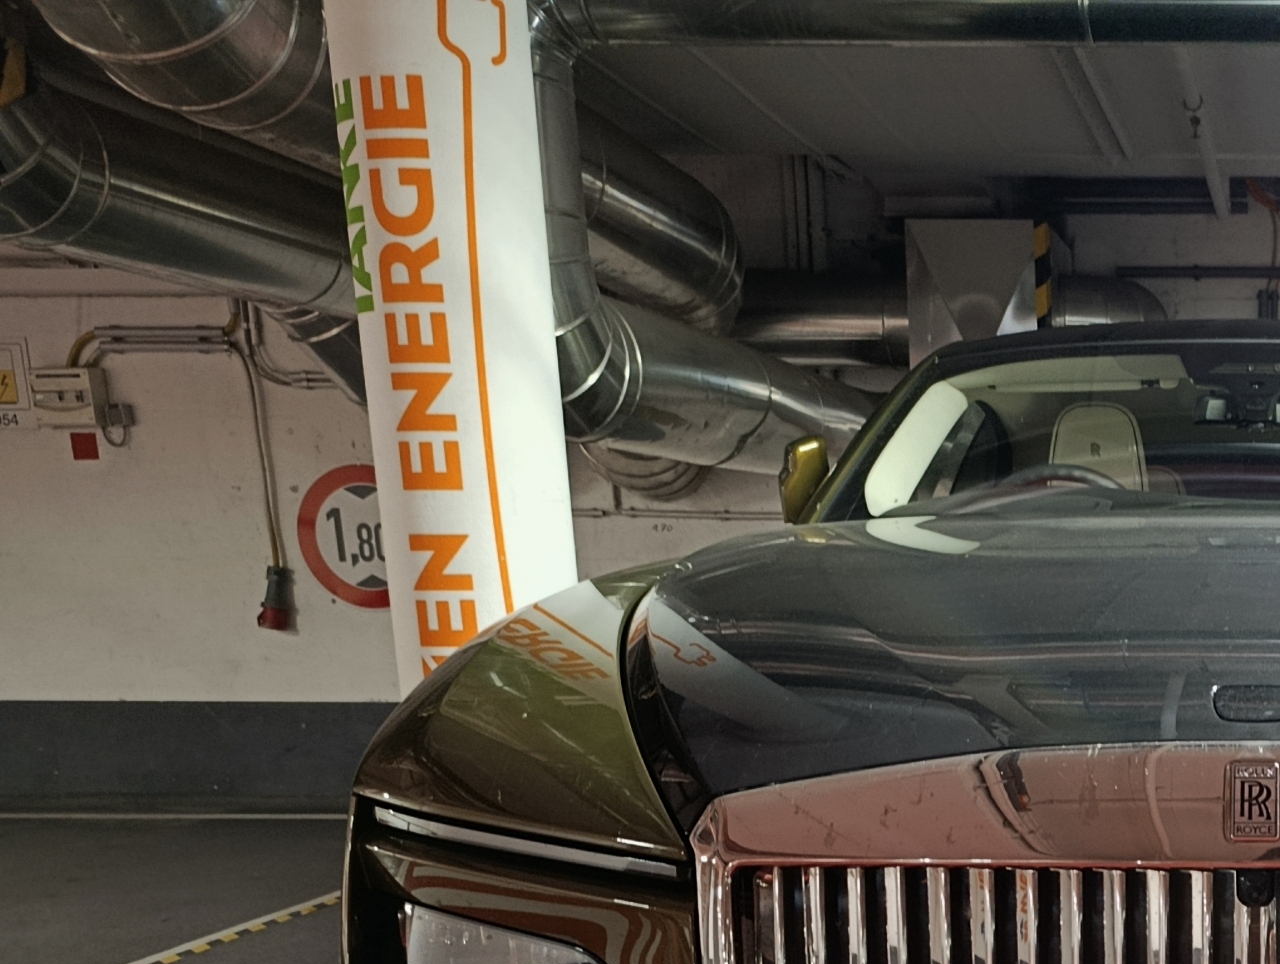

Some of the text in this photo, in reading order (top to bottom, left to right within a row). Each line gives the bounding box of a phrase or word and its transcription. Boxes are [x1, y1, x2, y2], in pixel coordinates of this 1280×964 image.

[359, 74, 478, 678] EN ENERGIE
[1240, 780, 1272, 821] RR
[1236, 825, 1273, 835] ROYCE
